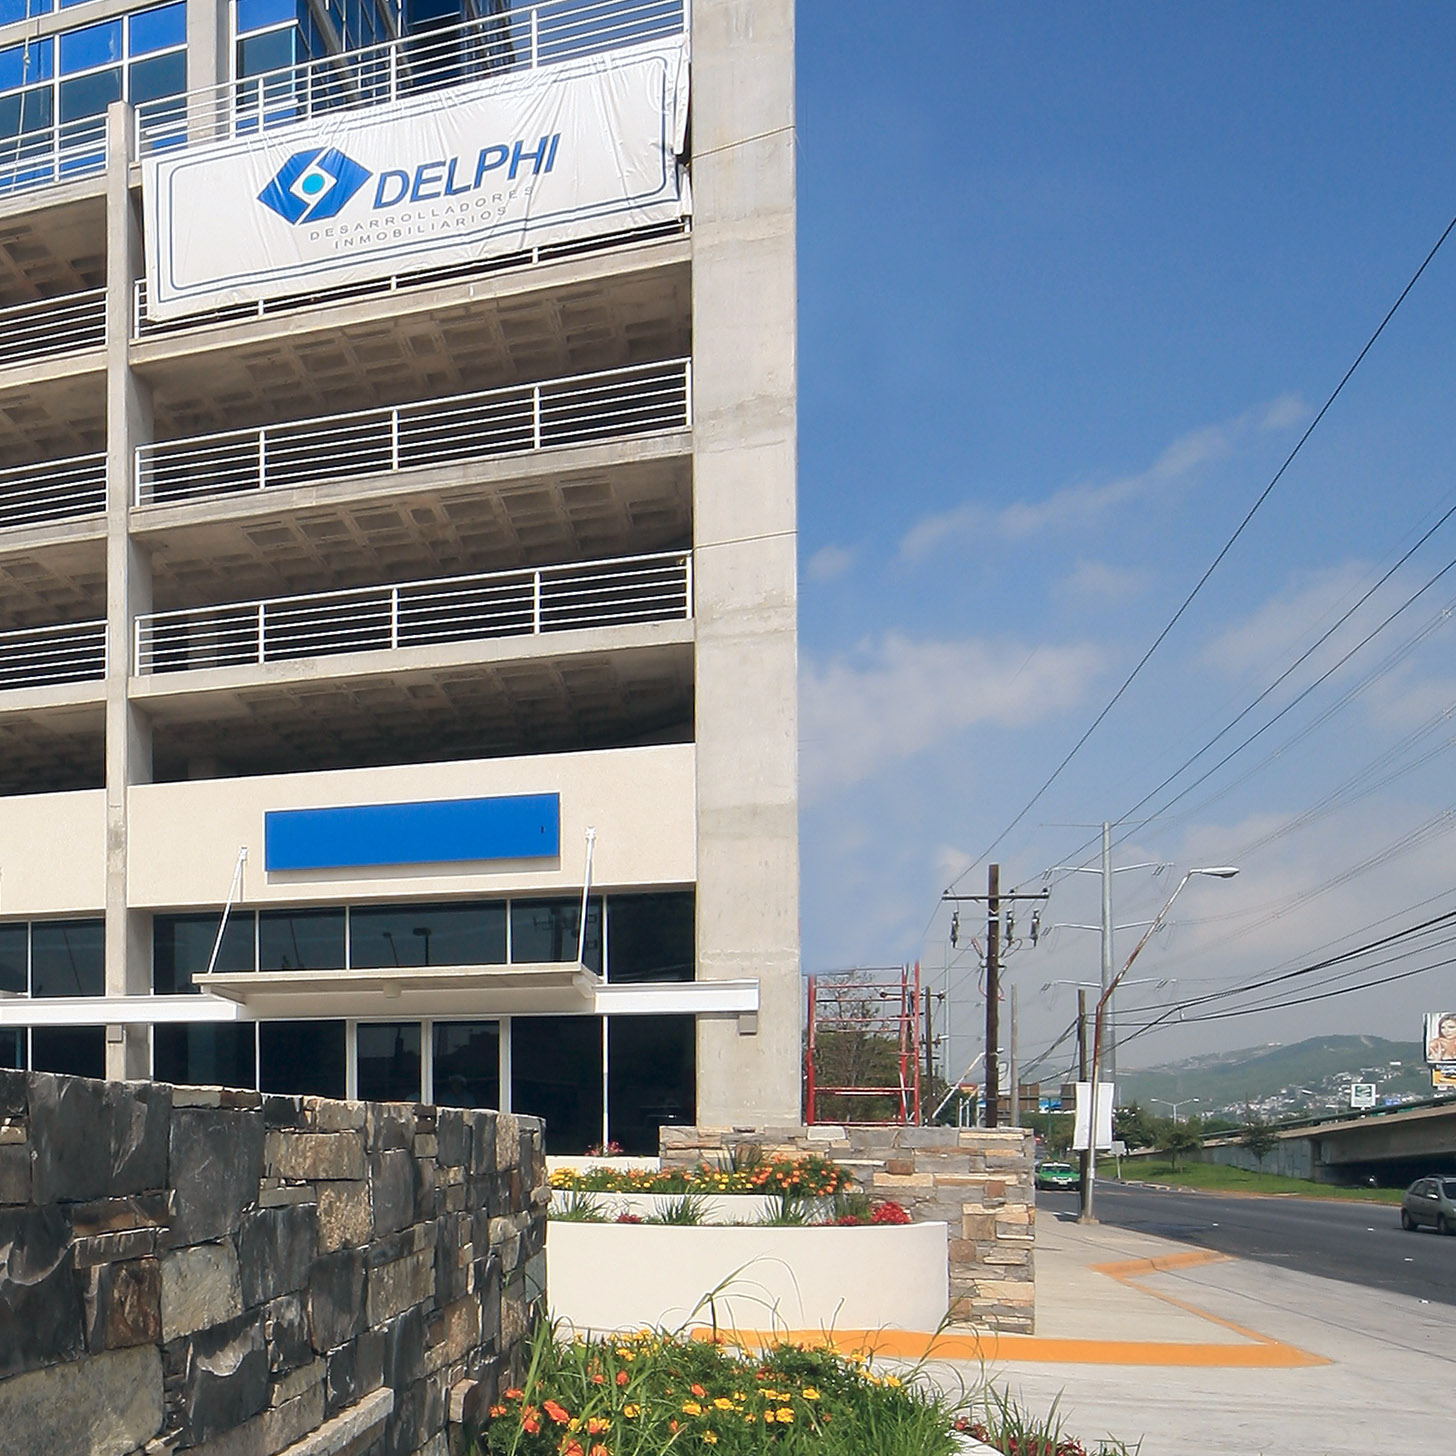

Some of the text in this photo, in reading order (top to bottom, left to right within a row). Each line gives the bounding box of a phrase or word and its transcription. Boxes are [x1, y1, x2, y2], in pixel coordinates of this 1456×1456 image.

[373, 133, 561, 209] DELPHI
[310, 186, 533, 242] DESARROLLADORES
[335, 207, 507, 249] INMOBILIARIOS
